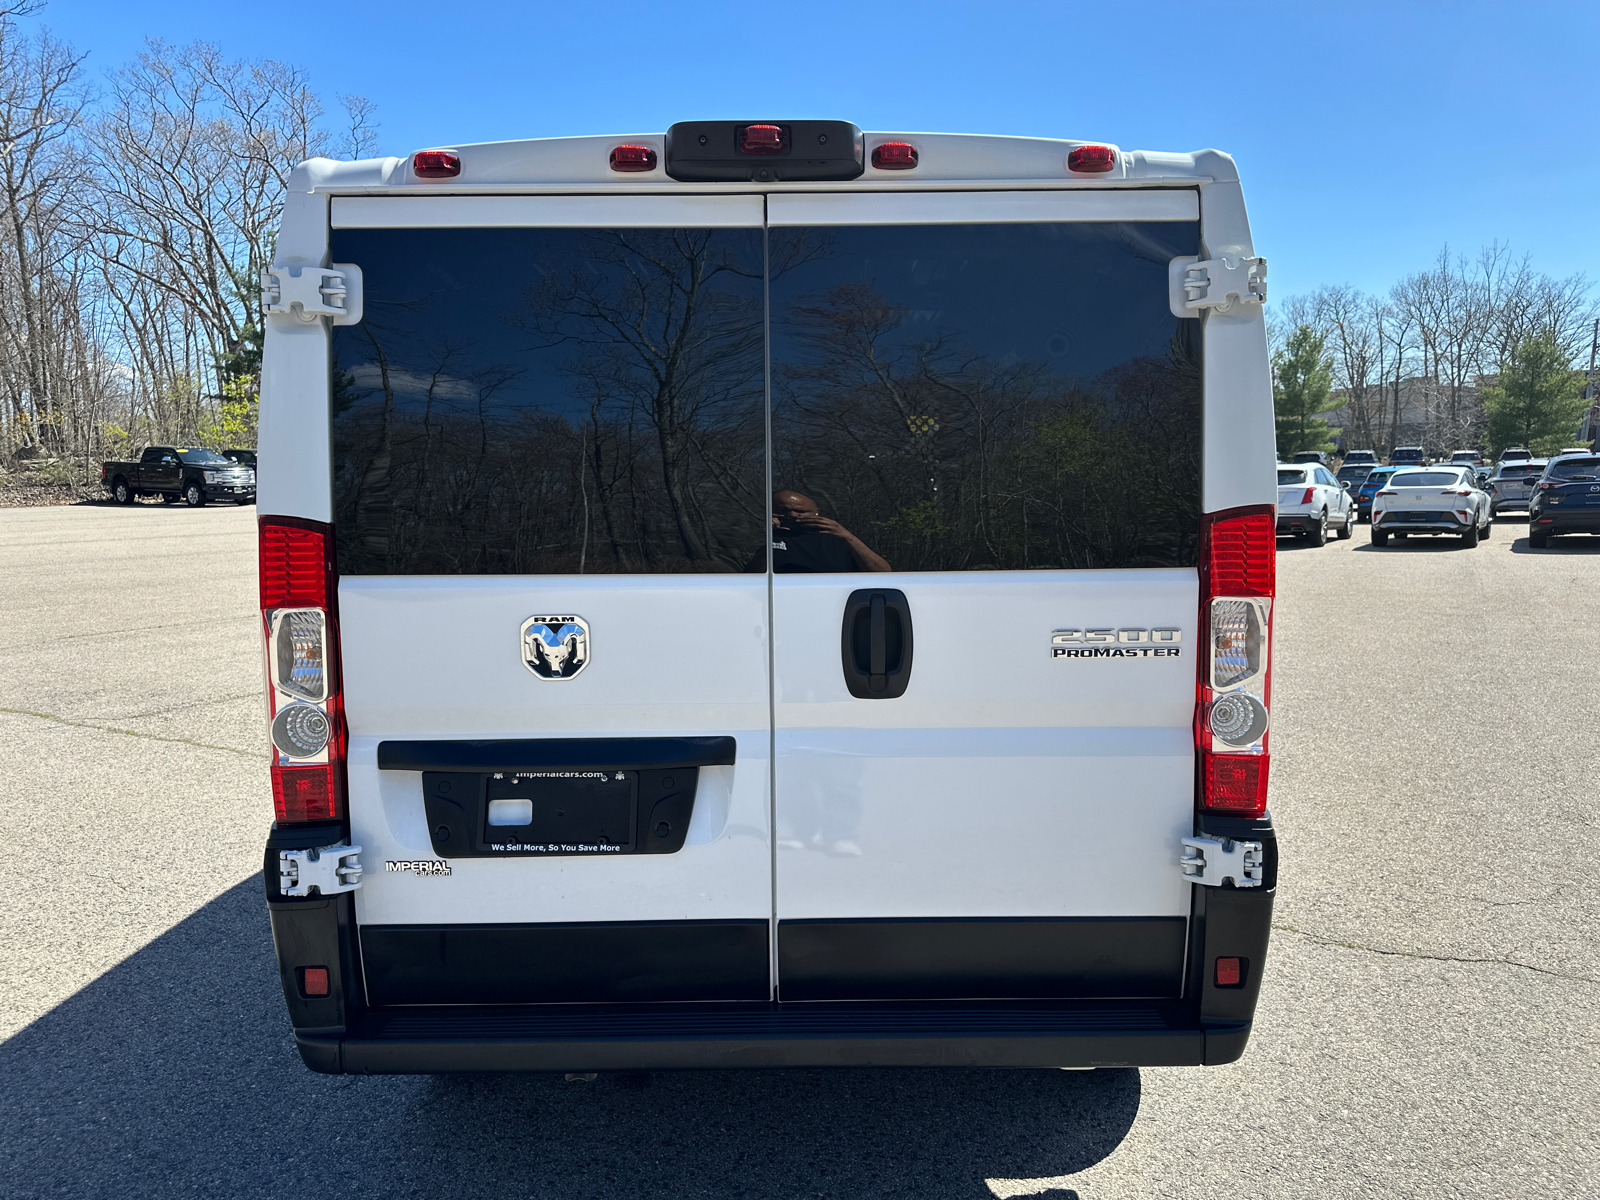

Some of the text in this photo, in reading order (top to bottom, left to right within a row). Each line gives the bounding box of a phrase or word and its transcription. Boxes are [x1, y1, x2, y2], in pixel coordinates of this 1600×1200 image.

[1051, 627, 1182, 644] 2500
[491, 843, 621, 853] We Sell More, So You Save More
[385, 860, 451, 871] IMPERIAL
